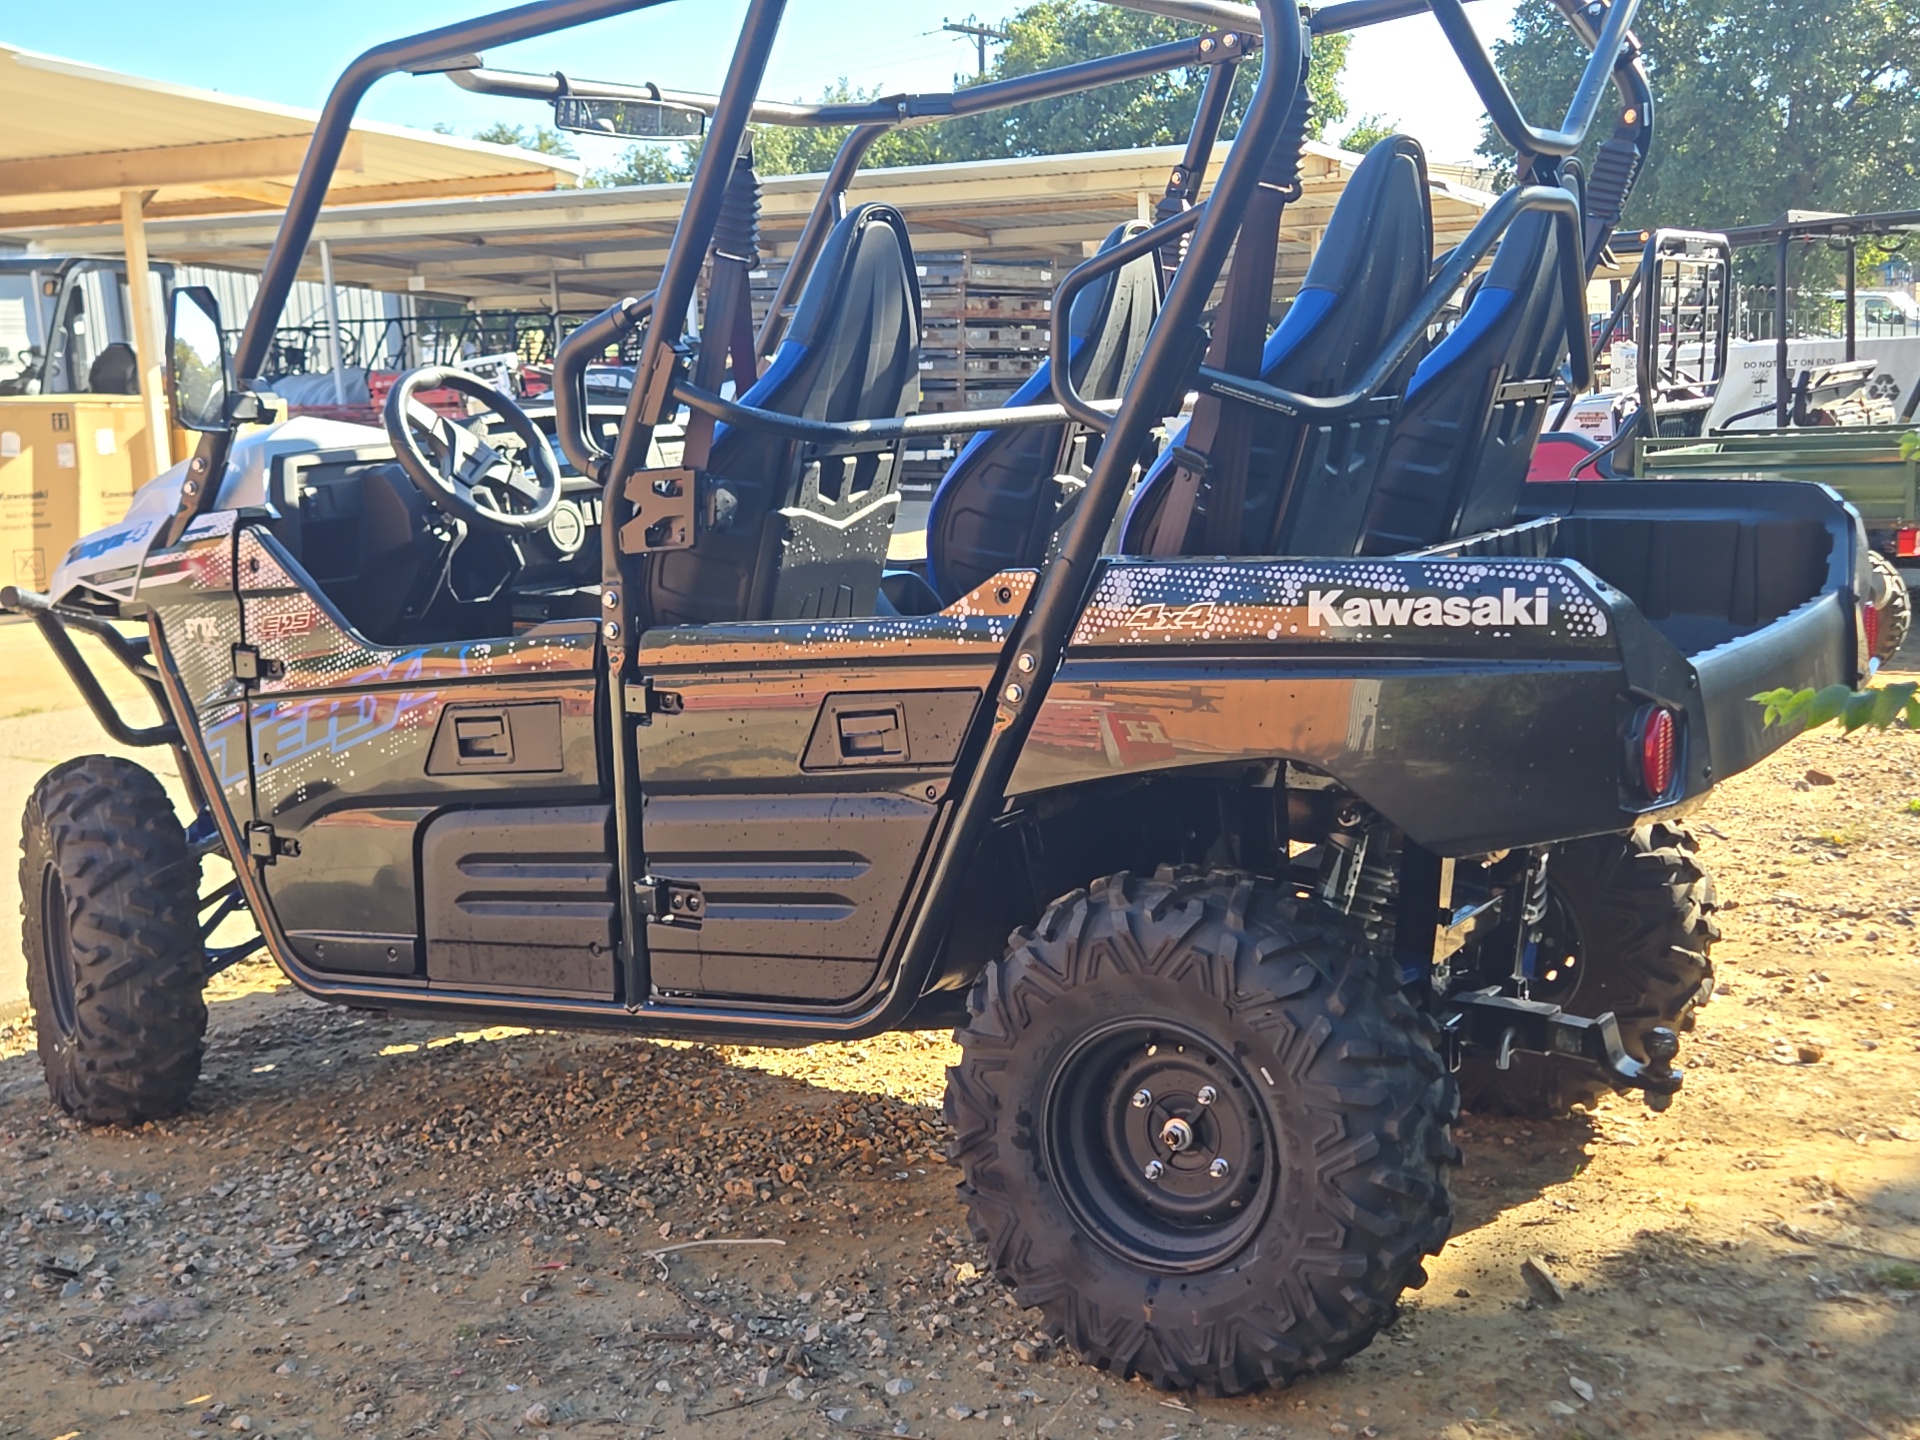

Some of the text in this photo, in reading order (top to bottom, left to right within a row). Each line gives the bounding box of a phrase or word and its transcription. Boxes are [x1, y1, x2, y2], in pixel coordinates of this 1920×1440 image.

[1744, 361, 1757, 369] DO
[1800, 358, 1814, 366] ON
[1816, 357, 1836, 366] END
[1125, 602, 1216, 630] 4x4
[1308, 587, 1549, 627] Kawasaki
[261, 611, 310, 634] EPS
